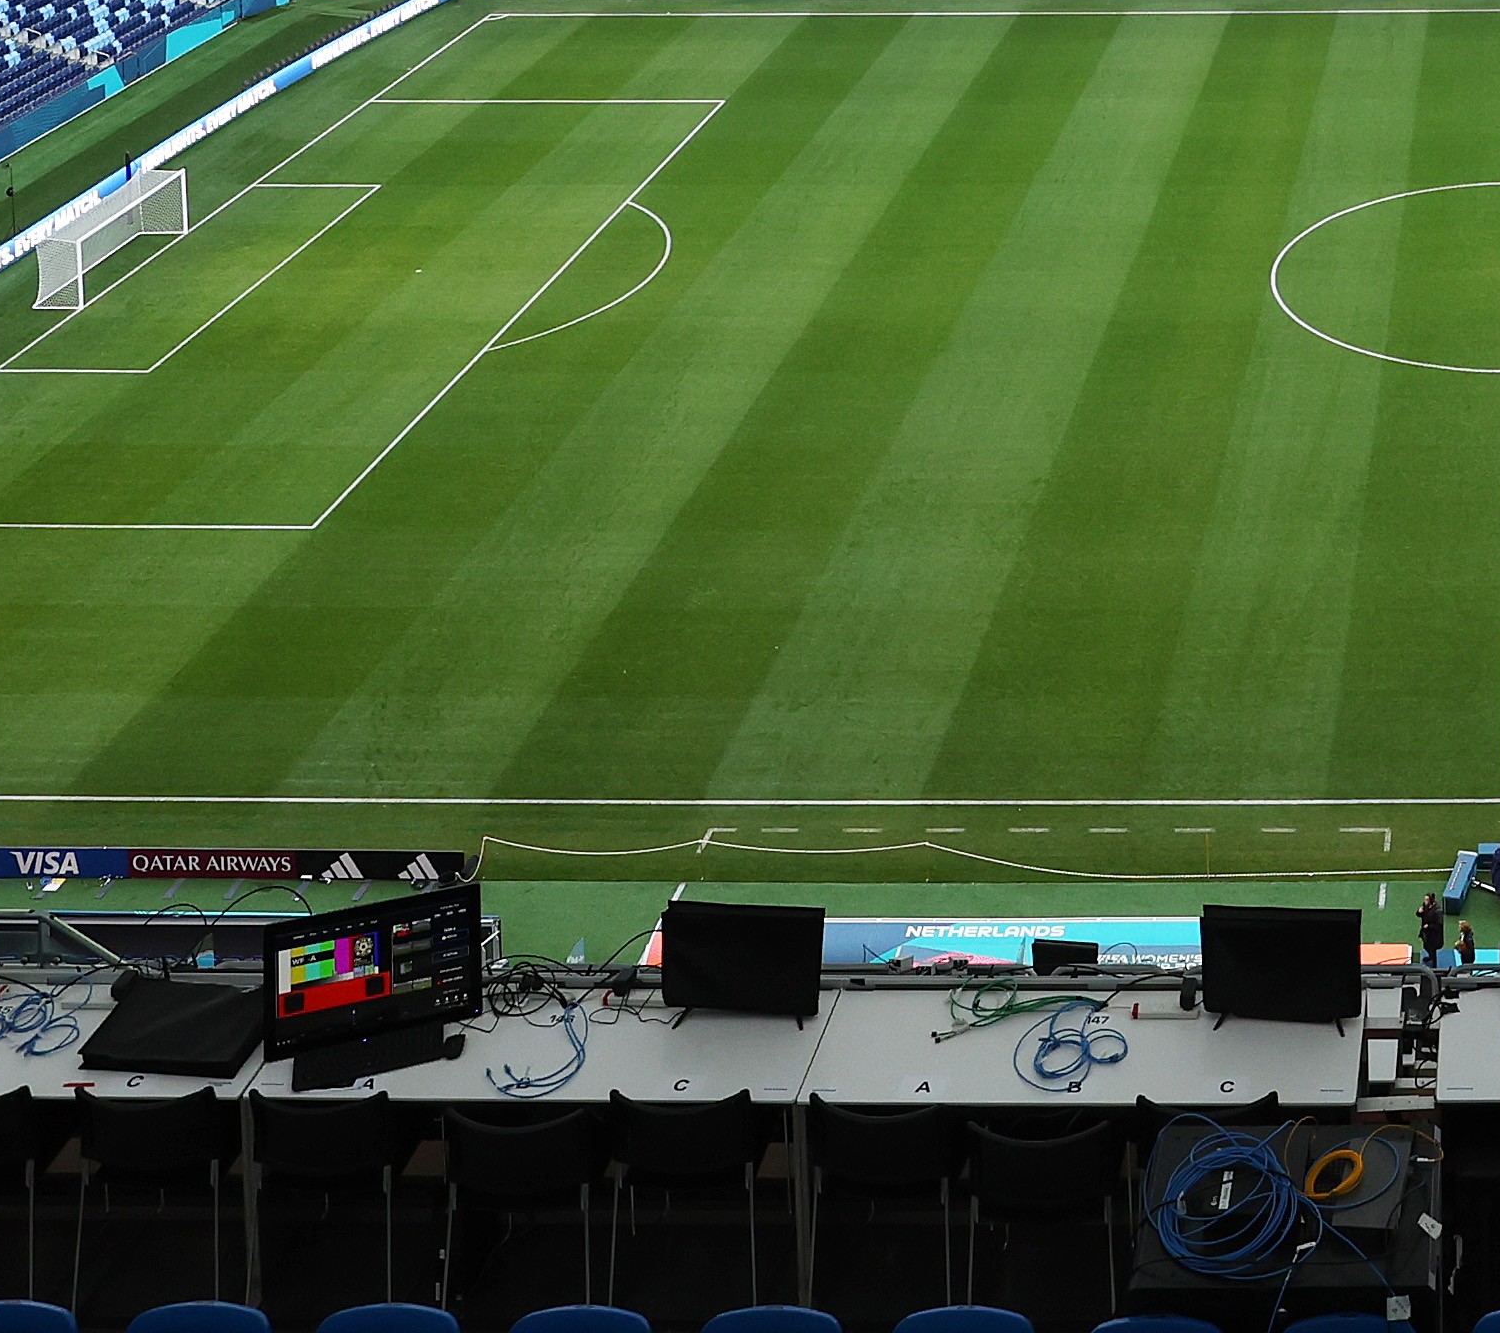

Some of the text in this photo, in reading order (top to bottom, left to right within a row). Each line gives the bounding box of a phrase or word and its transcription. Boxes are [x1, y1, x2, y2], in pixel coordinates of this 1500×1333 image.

[237, 80, 277, 114] MATCH.
[54, 190, 101, 231] MATCH.
[10, 851, 79, 875] VISA
[132, 854, 292, 875] QATAR AIRWAYS
[905, 925, 1065, 937] NETHERLANDS
[1086, 1015, 1109, 1025] 147
[127, 1075, 144, 1088] C
[673, 1079, 690, 1091] C
[915, 1082, 931, 1093] A
[1220, 1081, 1235, 1093] C
